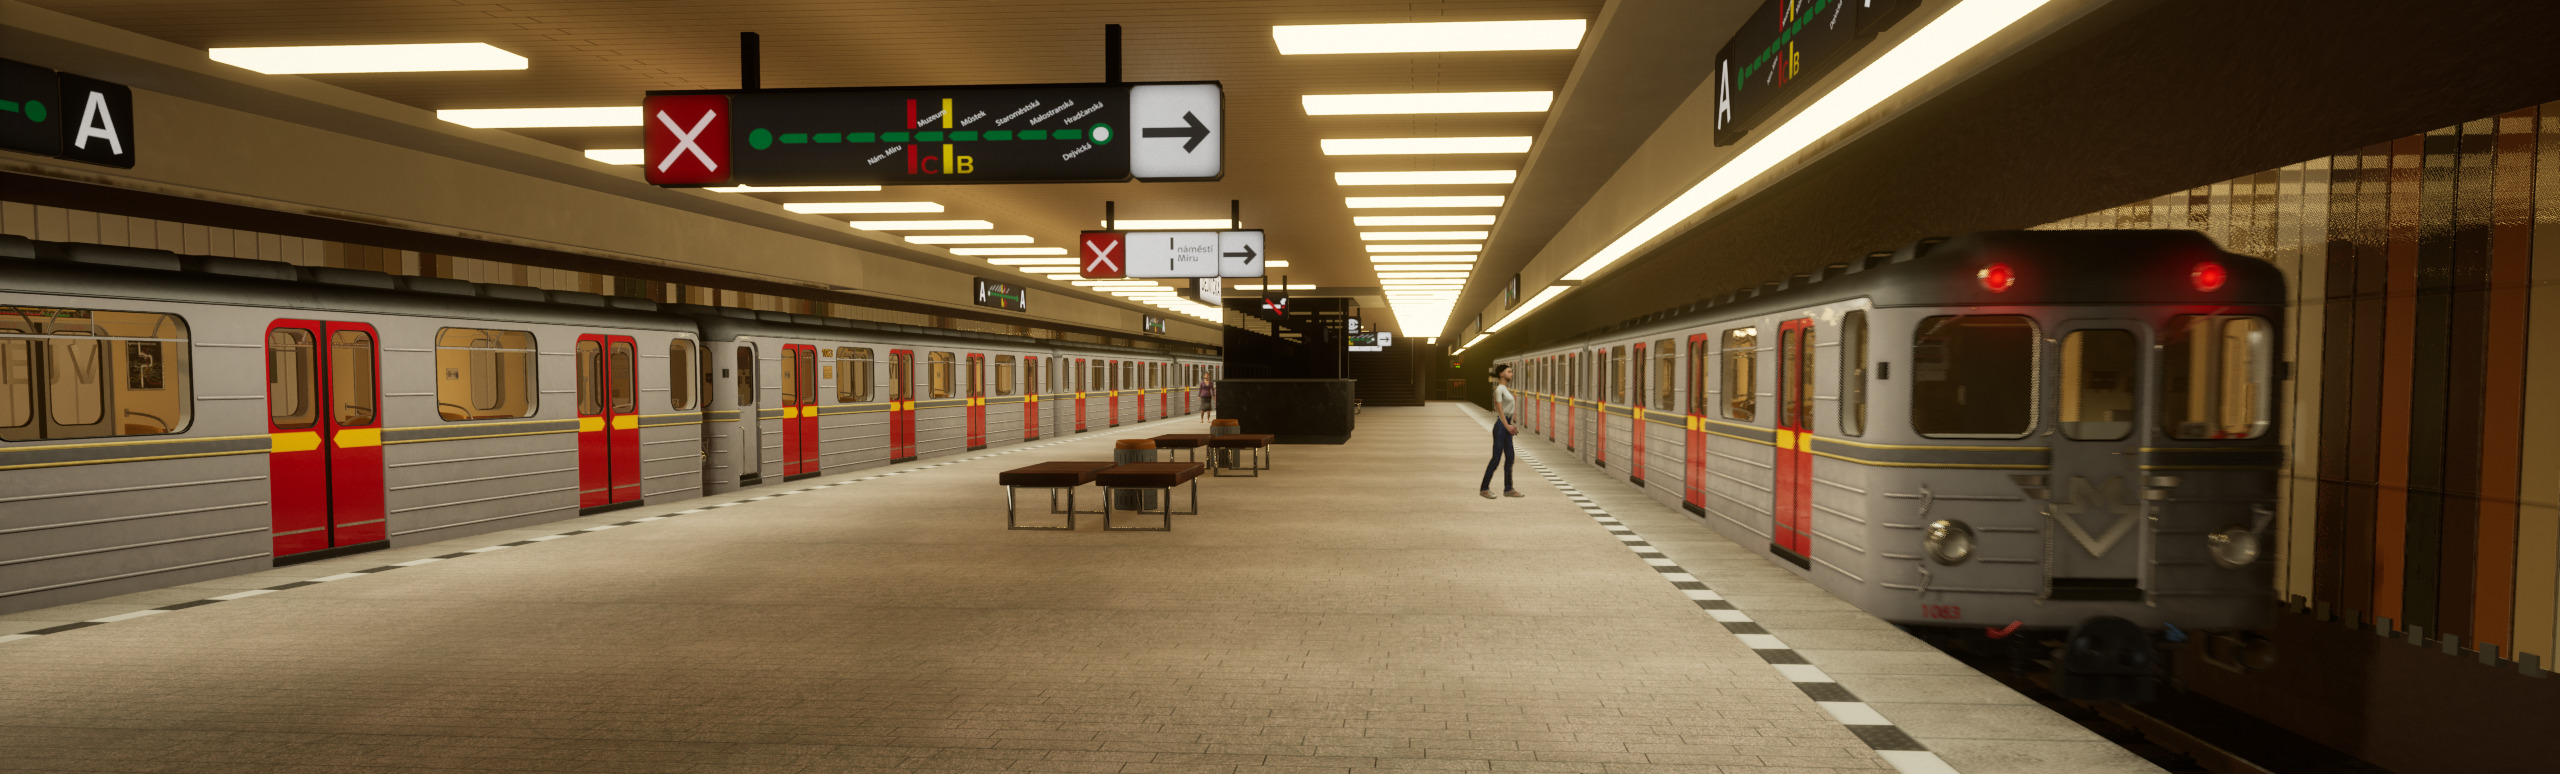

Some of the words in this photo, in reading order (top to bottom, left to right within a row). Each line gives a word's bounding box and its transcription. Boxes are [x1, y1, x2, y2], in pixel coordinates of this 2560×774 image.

[1782, 60, 1789, 84] C
[1793, 51, 1800, 76] B
[1717, 58, 1731, 131] A
[74, 90, 123, 155] A
[917, 108, 948, 128] Muzeum
[920, 155, 938, 174] C
[957, 155, 974, 174] B
[979, 281, 986, 302] A
[1019, 289, 1026, 309] A
